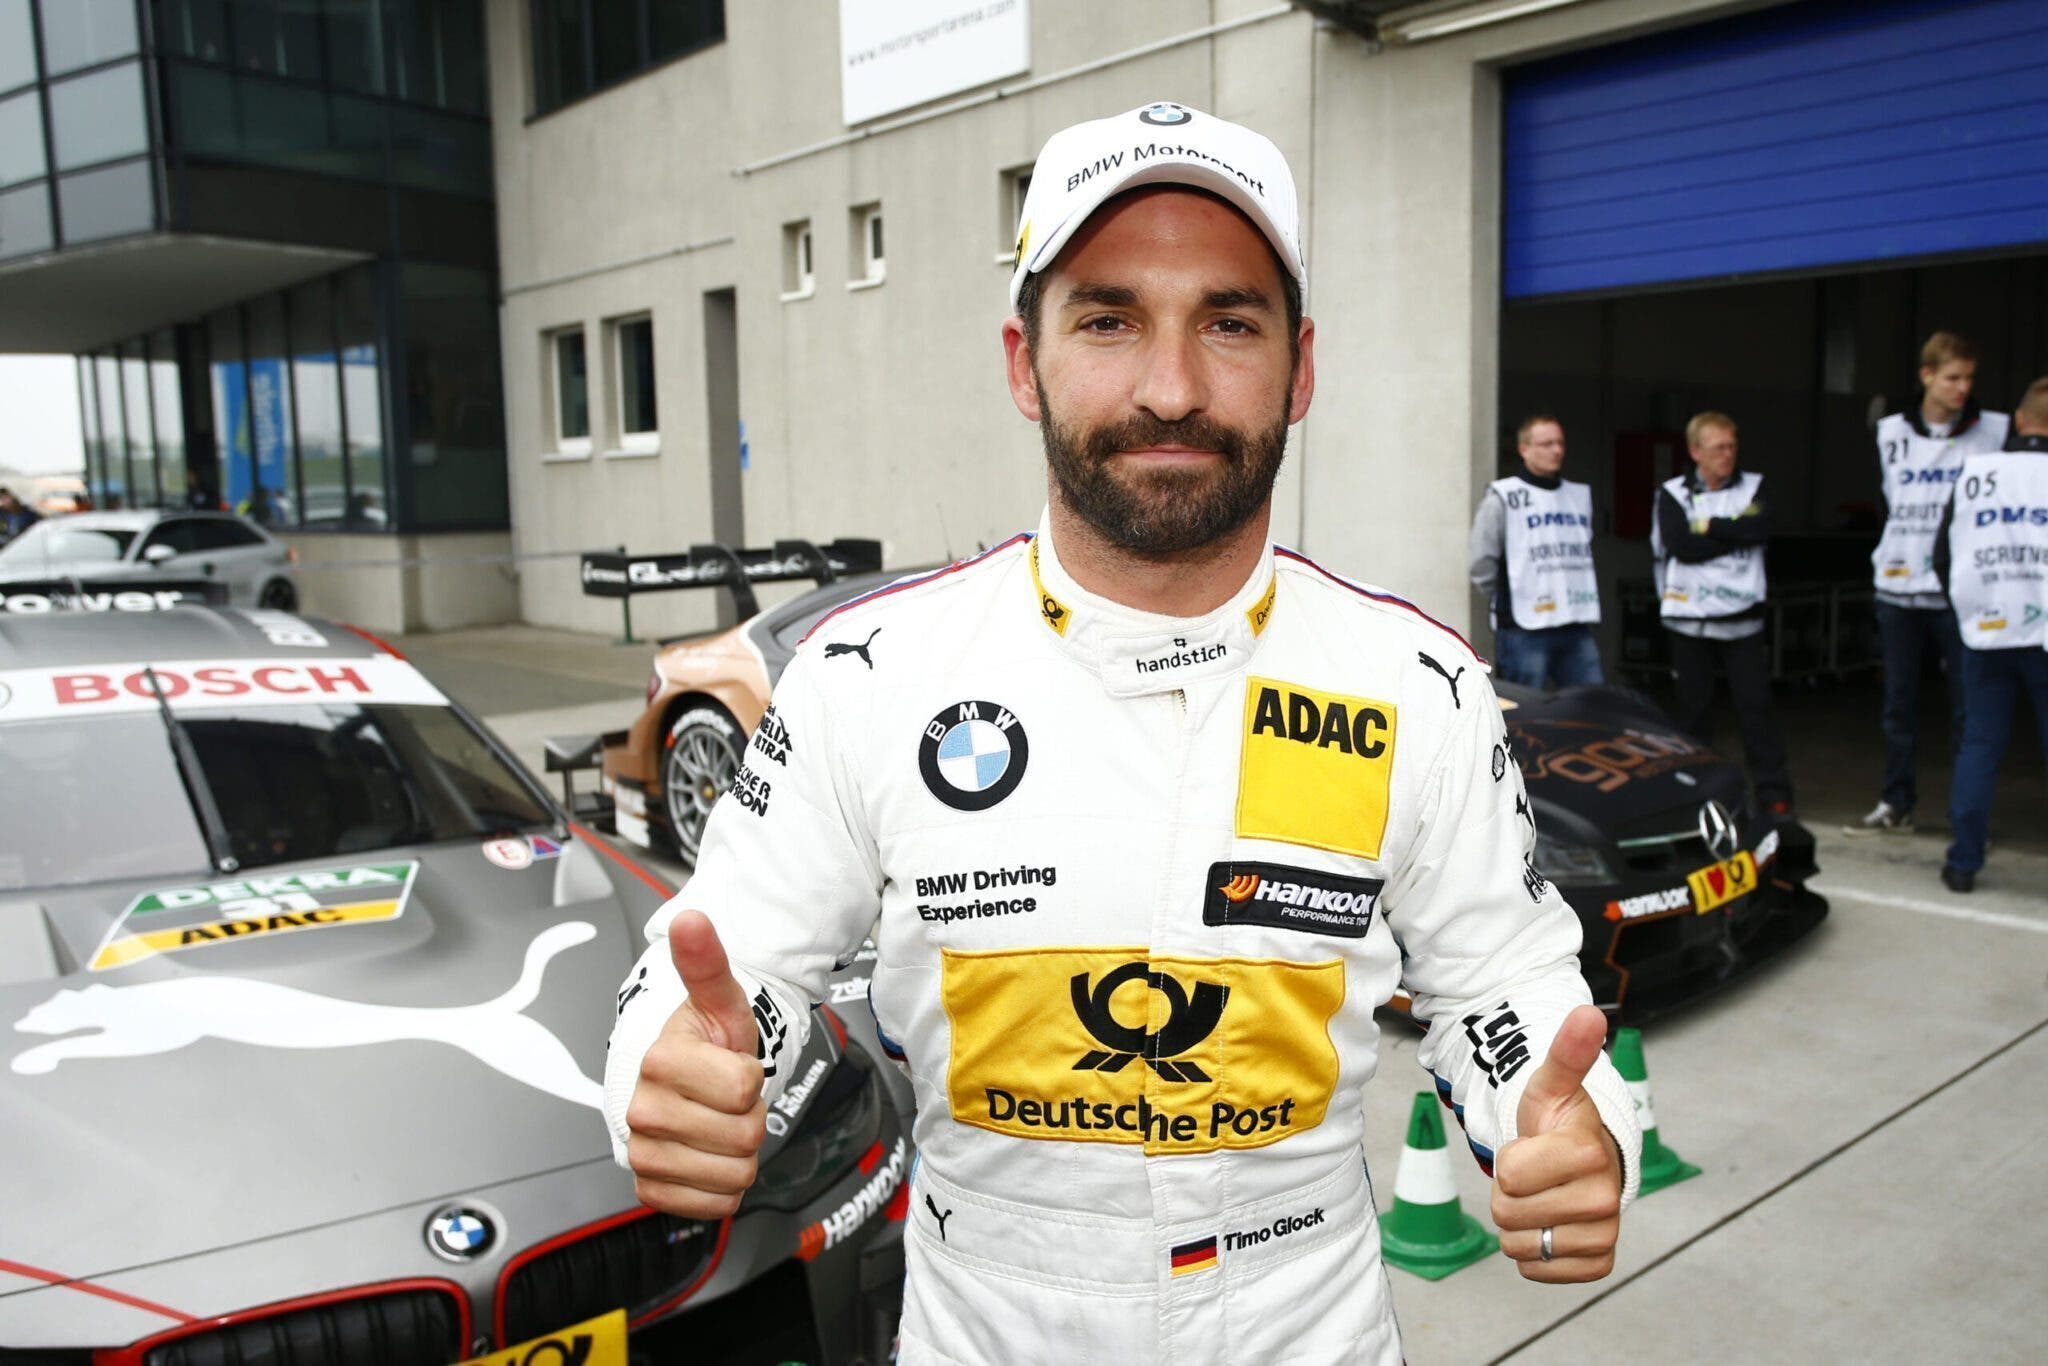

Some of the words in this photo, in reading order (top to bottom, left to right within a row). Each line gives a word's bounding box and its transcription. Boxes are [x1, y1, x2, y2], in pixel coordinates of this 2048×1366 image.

[1067, 151, 1124, 193] BMW
[1886, 438, 1908, 464] 21
[1507, 488, 1532, 510] 02
[1965, 470, 1997, 499] 05
[0, 591, 183, 614] ower
[1136, 643, 1228, 673] handstich
[52, 666, 373, 705] BOSCH
[926, 701, 1020, 742] BMW
[1252, 687, 1388, 759] ADAC
[156, 868, 399, 909] DEKRA
[916, 873, 968, 897] BMW
[973, 865, 1057, 890] Driving
[181, 910, 345, 944] ADAC
[917, 897, 1037, 925] Experience
[1281, 907, 1355, 925] PERFORMANCE
[985, 1088, 1197, 1142] Deutsche
[1210, 1098, 1296, 1139] Post
[1223, 1227, 1271, 1251] Timo
[1272, 1207, 1325, 1237] Glock
